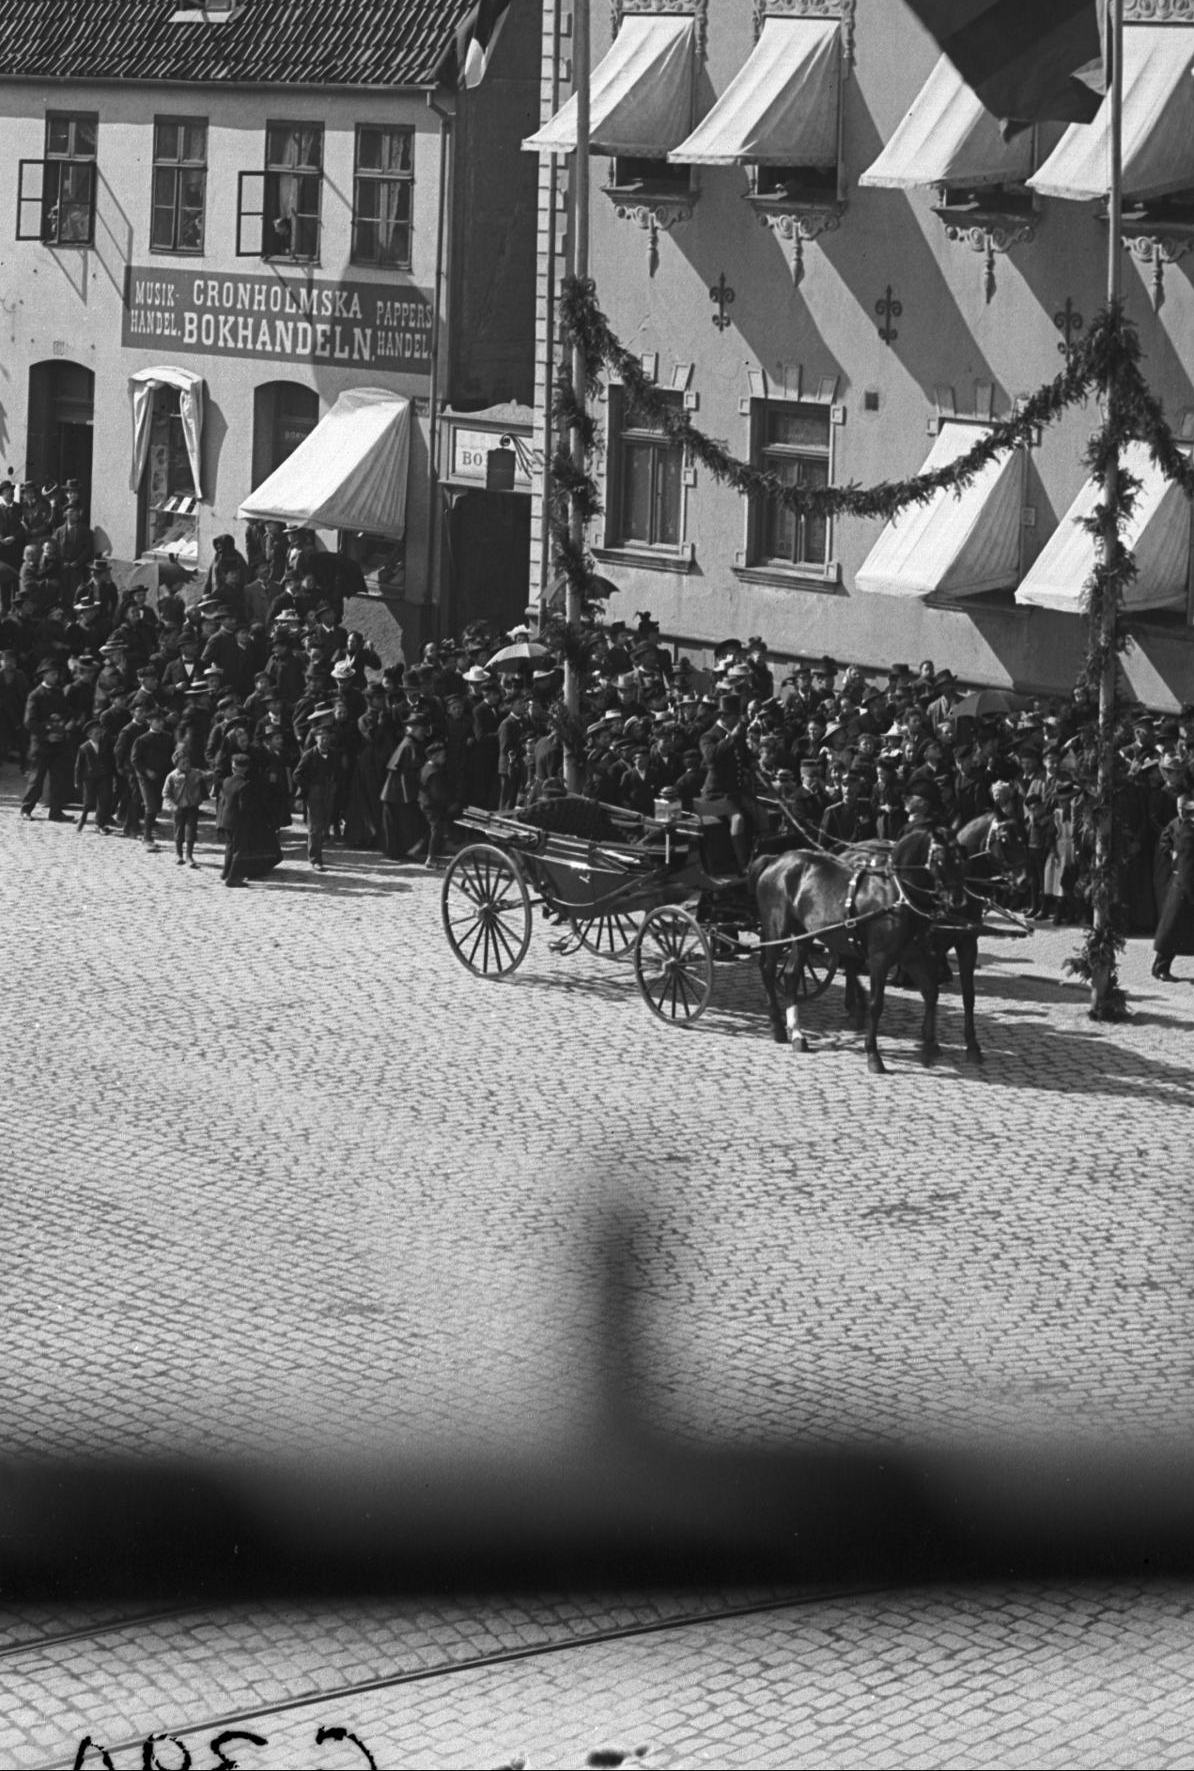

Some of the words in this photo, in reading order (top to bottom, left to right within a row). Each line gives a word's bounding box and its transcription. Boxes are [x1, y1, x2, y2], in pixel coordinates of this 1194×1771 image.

[135, 280, 180, 307] MUSIK-
[193, 279, 362, 319] CRONHOLMSKA
[130, 309, 181, 337] HANDEL.
[183, 311, 376, 362] BOKHANDELN.
